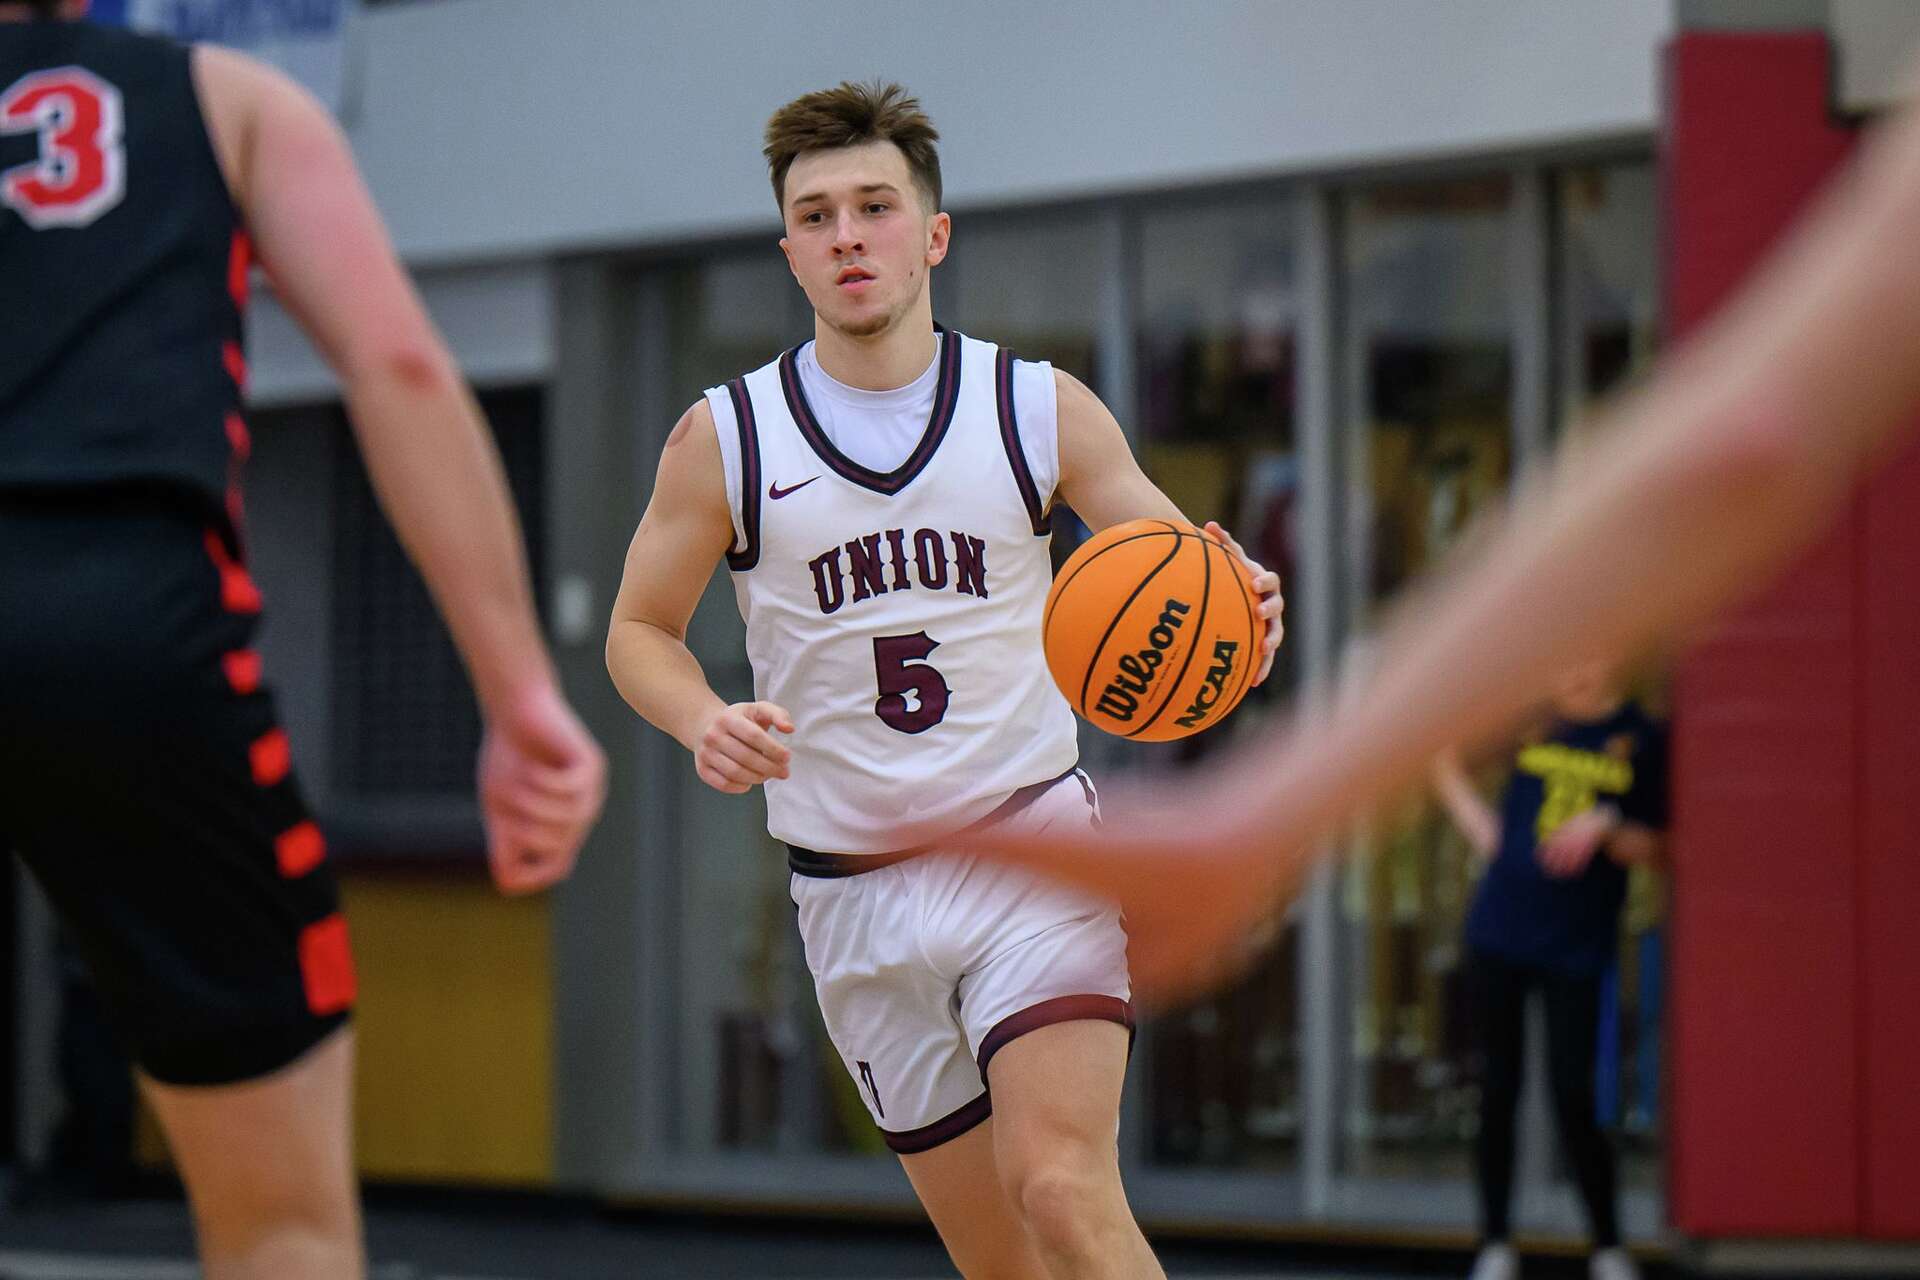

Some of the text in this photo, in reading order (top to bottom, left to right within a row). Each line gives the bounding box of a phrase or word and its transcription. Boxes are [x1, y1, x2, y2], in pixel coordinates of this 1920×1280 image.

[0, 65, 127, 231] 3
[808, 528, 989, 614] UNION
[872, 630, 953, 734] 5
[1094, 598, 1192, 722] Wilson
[1173, 641, 1239, 728] NCAA
